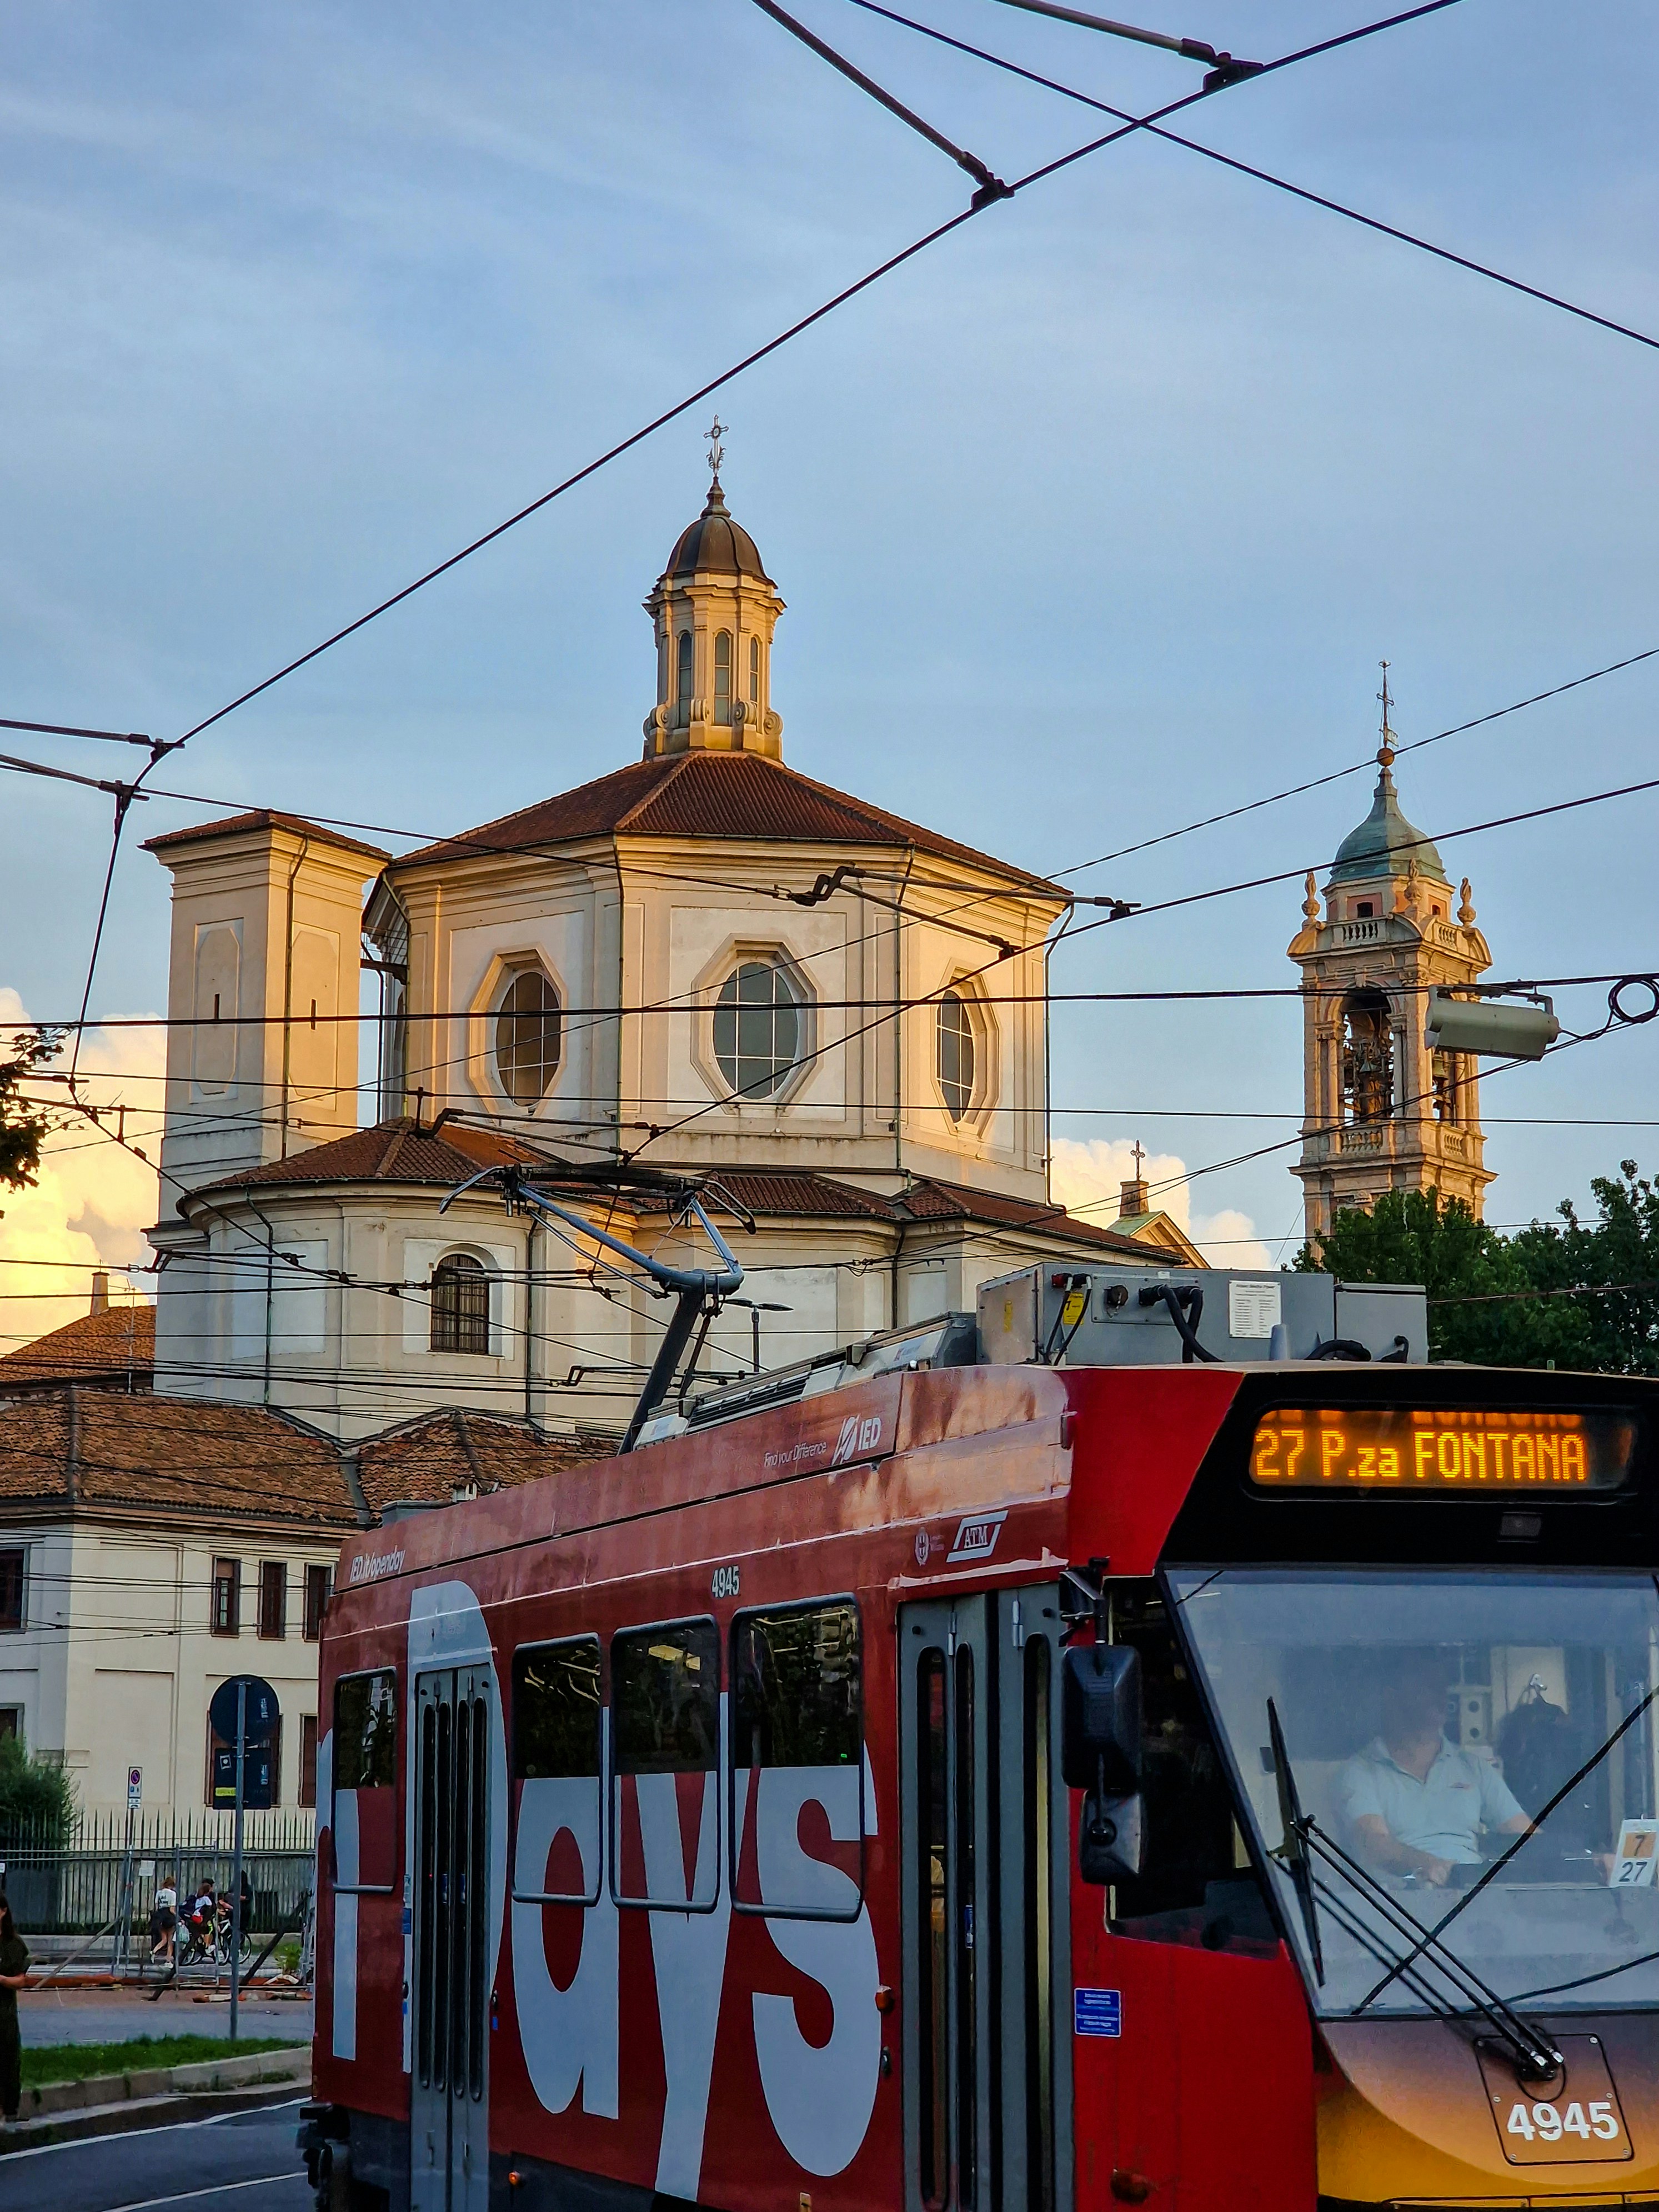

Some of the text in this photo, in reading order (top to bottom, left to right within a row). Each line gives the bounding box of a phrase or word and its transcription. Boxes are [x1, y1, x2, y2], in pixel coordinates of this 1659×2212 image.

[858, 1417, 881, 1452] IED
[1256, 1429, 1586, 1481] 27 P.za FONTANA
[964, 1525, 988, 1549] ATM
[349, 1545, 406, 1583] IED.it/openday
[711, 1565, 740, 1598] 4945
[1634, 1835, 1646, 1856] 7
[1618, 1861, 1648, 1883] 27
[1507, 2101, 1619, 2141] 4945
